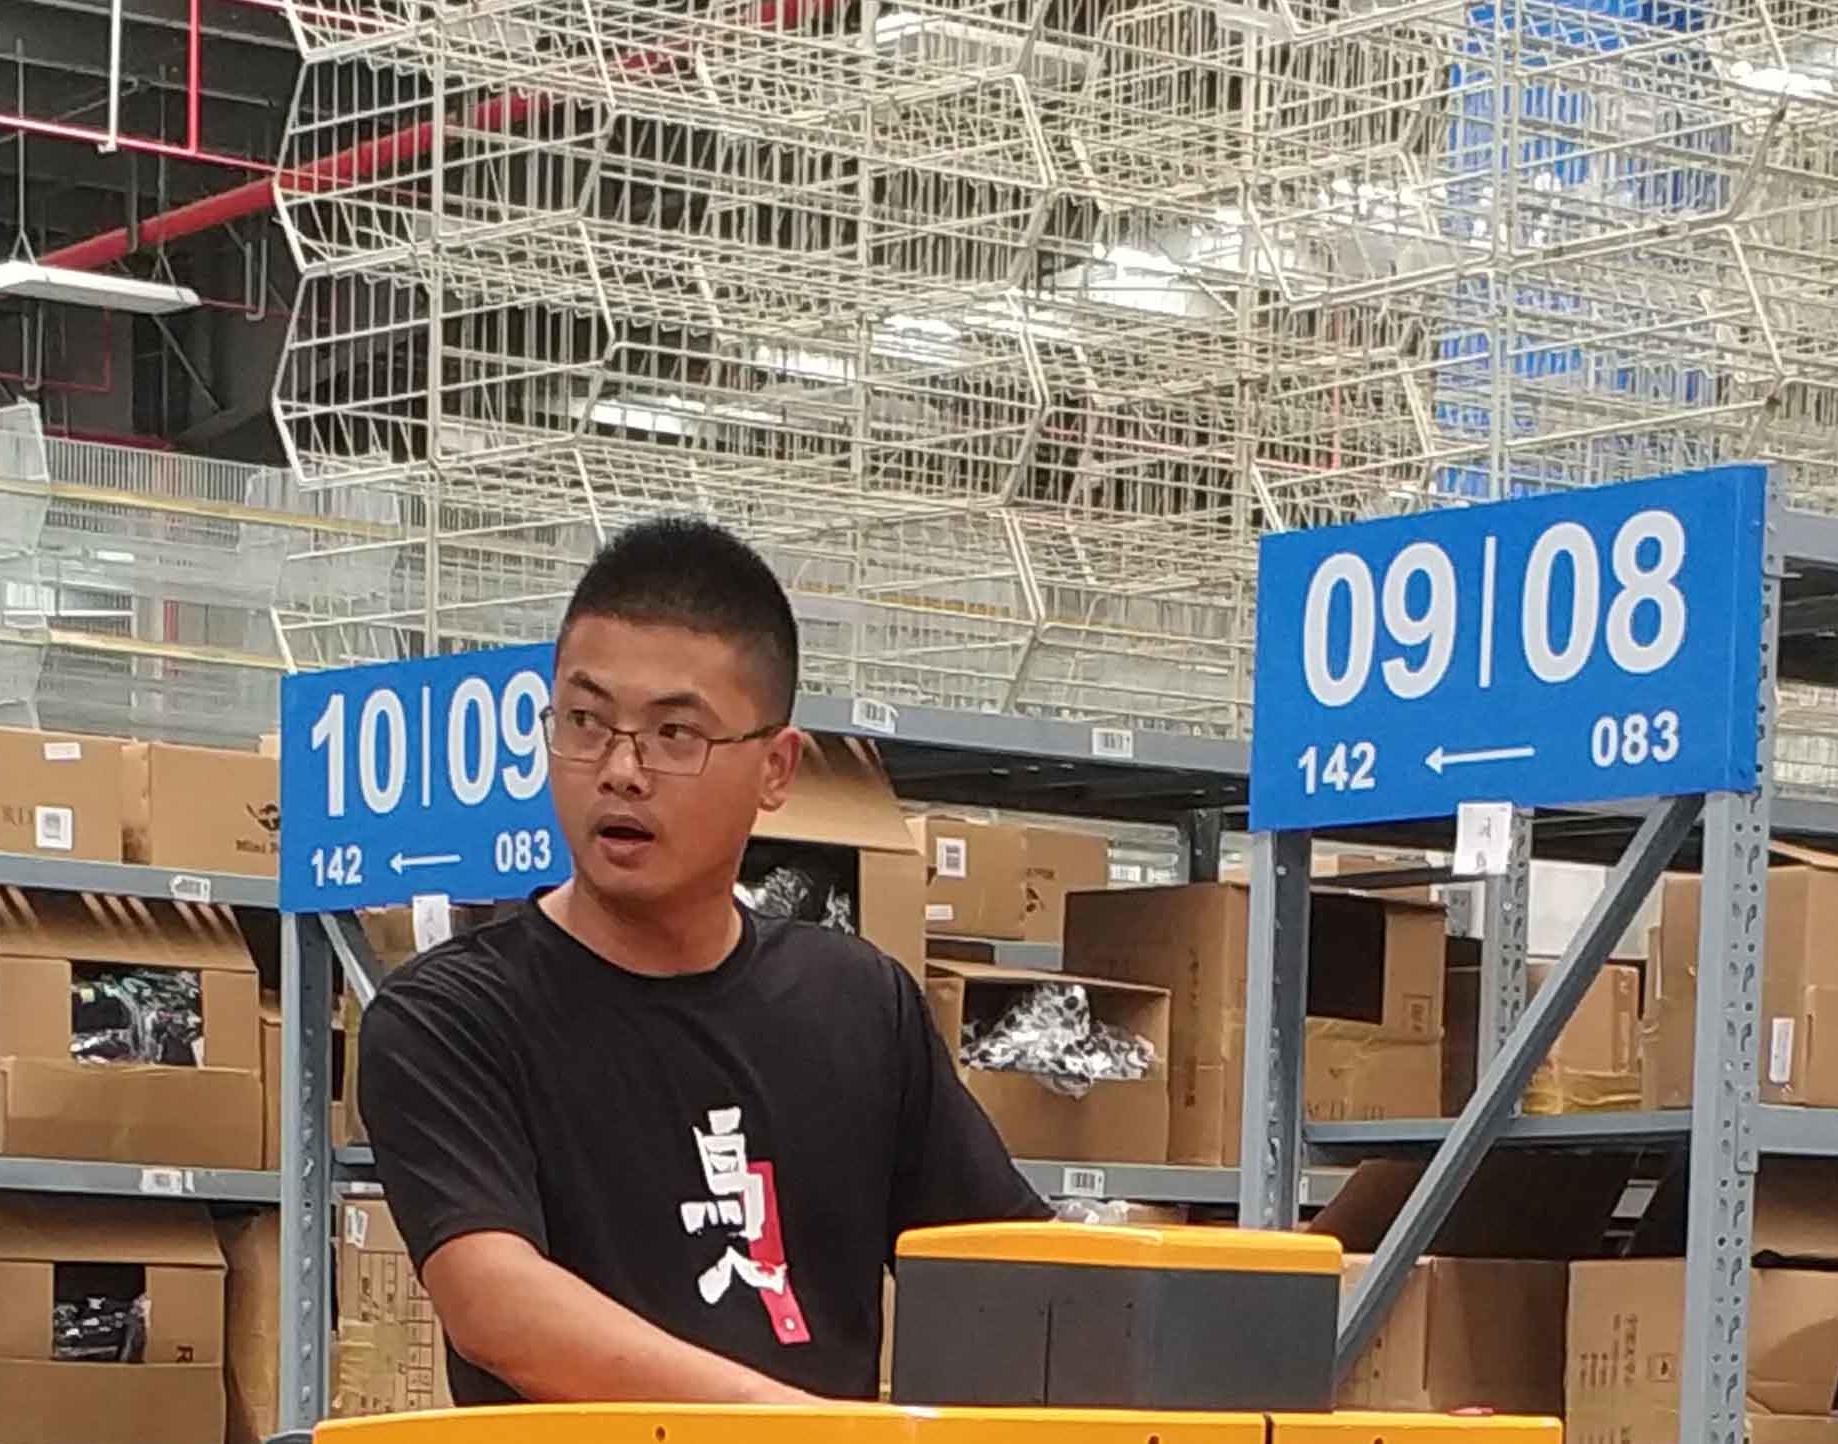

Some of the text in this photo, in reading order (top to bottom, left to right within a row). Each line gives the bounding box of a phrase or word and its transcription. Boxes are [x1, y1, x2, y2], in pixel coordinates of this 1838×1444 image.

[1298, 710, 1680, 794] 142 083
[311, 829, 552, 888] 142 083
